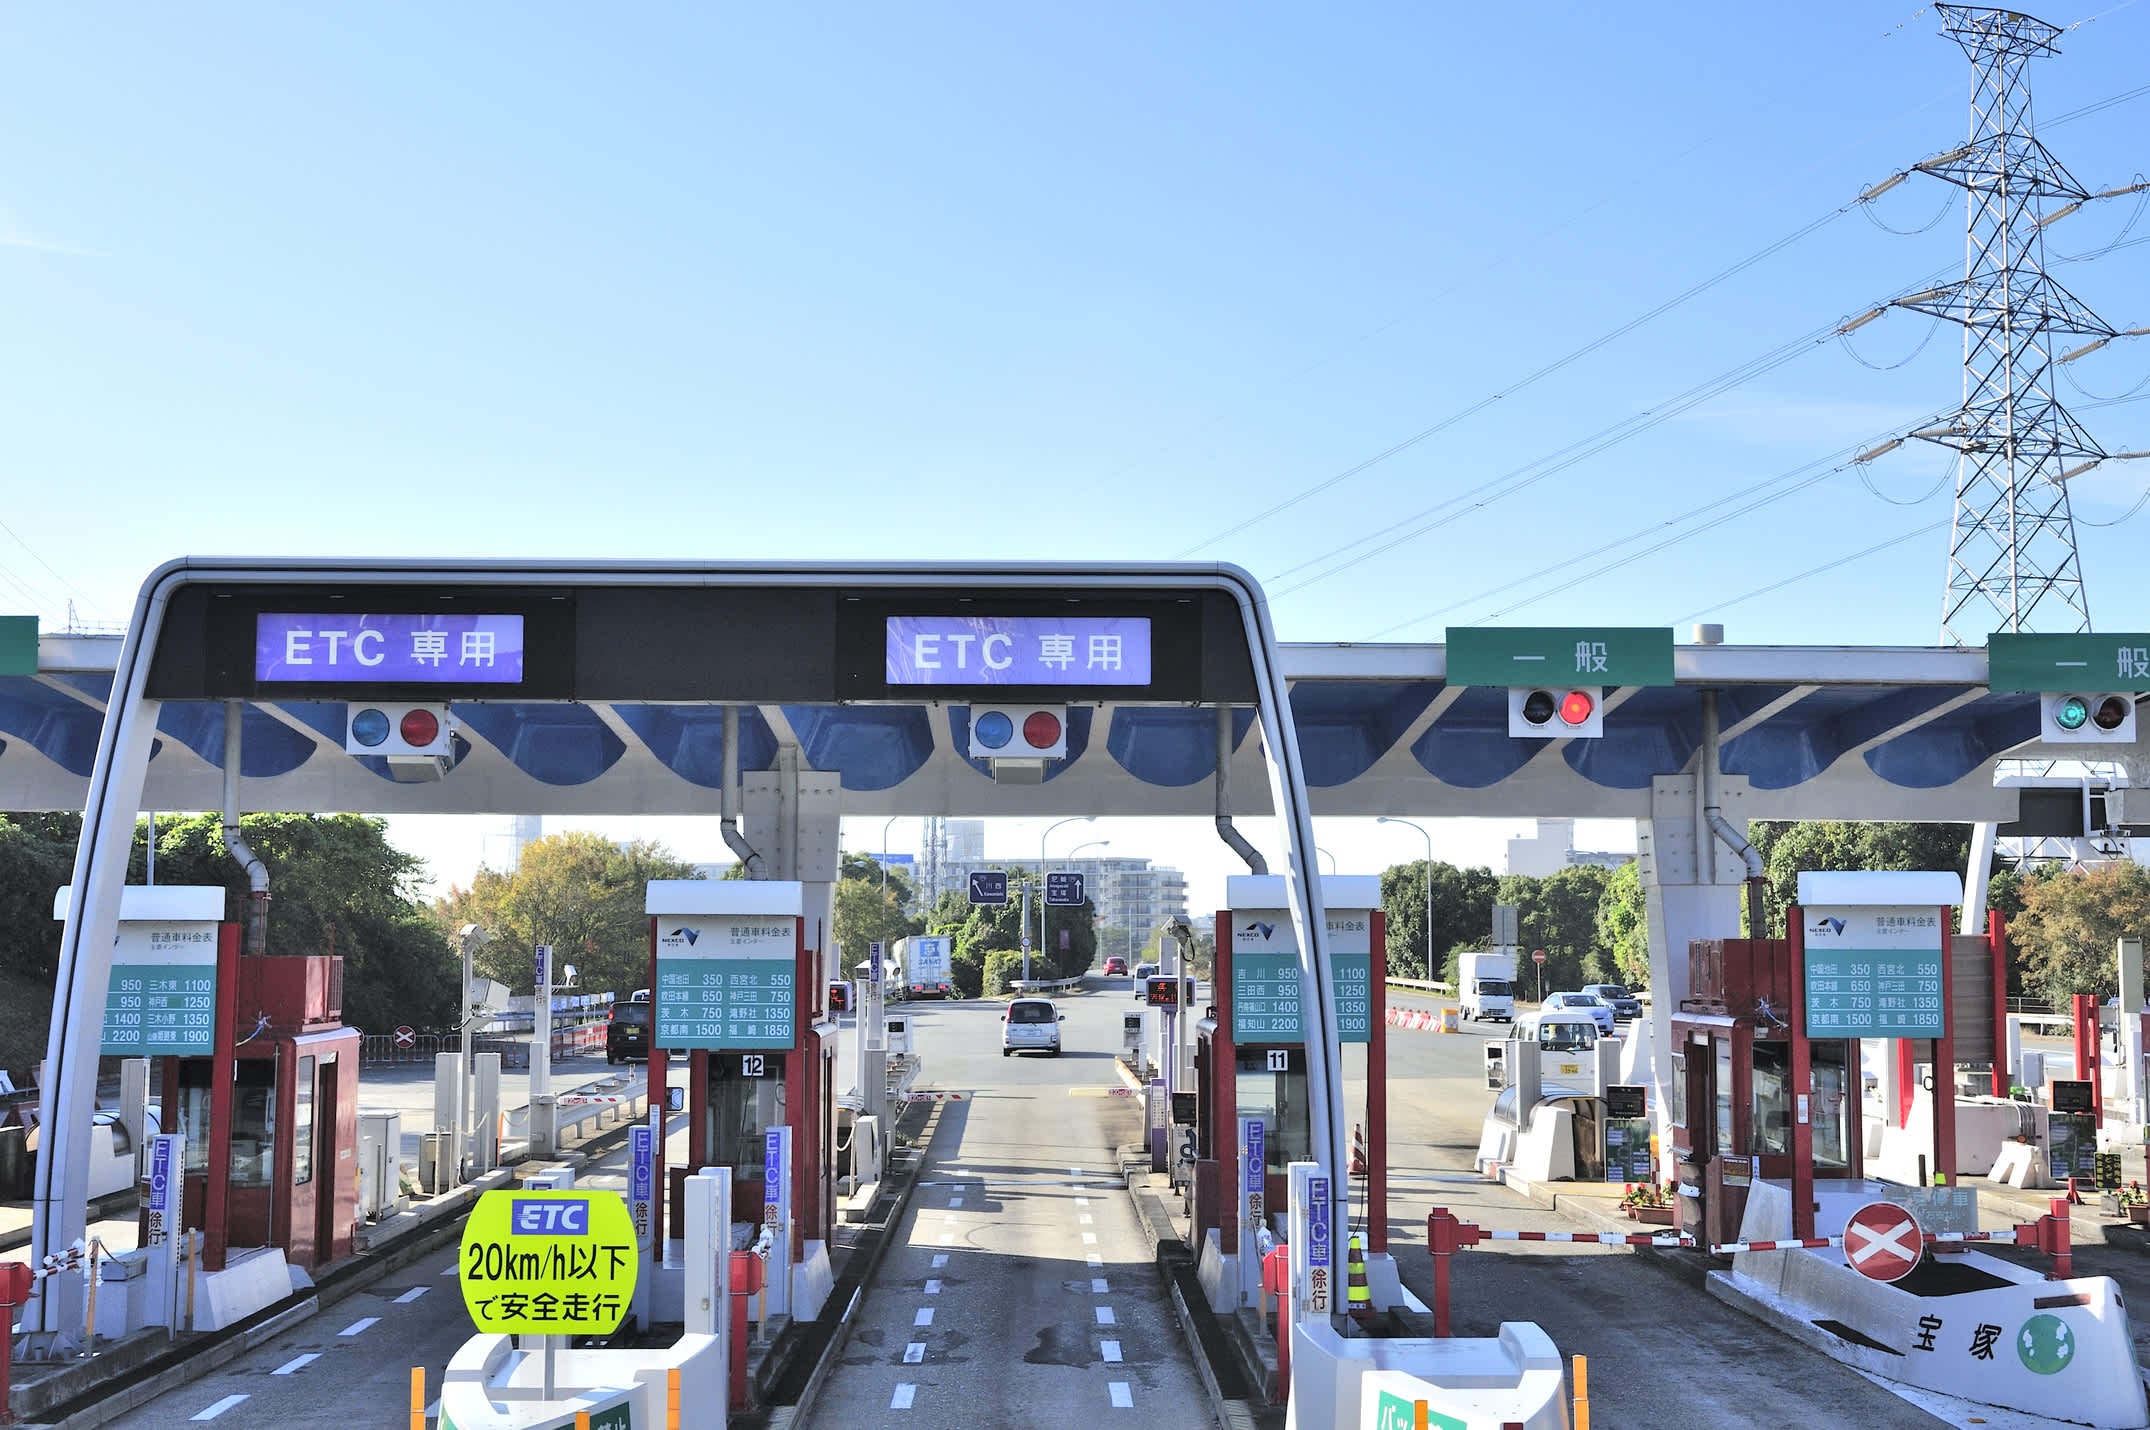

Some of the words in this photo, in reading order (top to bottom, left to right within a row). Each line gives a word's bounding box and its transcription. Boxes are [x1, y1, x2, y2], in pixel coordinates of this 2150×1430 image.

[286, 630, 385, 667] ETC
[410, 630, 495, 667] 専用
[915, 633, 1013, 670] ETC
[1038, 634, 1122, 671] 専用
[1876, 917, 1937, 927] 普通車料金表
[151, 932, 213, 943] 普通車料金表
[731, 927, 791, 937] 普通車料金表
[1278, 968, 1298, 979] 950
[1340, 968, 1365, 979] 1100
[1850, 964, 1870, 975] 350
[1878, 964, 1905, 975] 西宮北
[1917, 964, 1937, 975] 550
[662, 974, 689, 985] 中国池田
[702, 974, 722, 985] 350
[730, 975, 757, 985] 西宮北
[771, 975, 791, 986] 550
[121, 980, 142, 991] 950
[149, 980, 177, 991] 三木東
[185, 980, 211, 991] 1100
[1238, 985, 1265, 996] 三田西
[1278, 985, 1298, 996] 950
[1340, 985, 1365, 996] 1250
[1850, 980, 1871, 992] 650
[1918, 981, 1938, 992] 750
[702, 991, 722, 1002] 650
[730, 992, 757, 1002] 神戸三田
[771, 992, 791, 1002] 750
[120, 997, 141, 1008] 950
[184, 997, 210, 1008] 1250
[1272, 1001, 1298, 1013] 1400
[1340, 1001, 1365, 1012] 1350
[1851, 997, 1871, 1008] 750
[1913, 997, 1938, 1008] 1350
[115, 1013, 141, 1025] 1400
[148, 1014, 176, 1025] 三木小野
[184, 1013, 210, 1025] 1350
[702, 1008, 722, 1019] 750
[764, 1008, 790, 1019] 1350
[1811, 1014, 1839, 1025] 京都南
[1846, 1013, 1872, 1025] 1500
[1912, 1013, 1939, 1025] 1850
[1238, 1018, 1265, 1029] 福知山
[1271, 1018, 1298, 1030] 2200
[1340, 1018, 1365, 1030] 1900
[660, 1024, 689, 1036] 京都南
[696, 1024, 722, 1036] 1500
[764, 1025, 790, 1036] 1850
[113, 1030, 140, 1042] 2200
[183, 1030, 209, 1042] 1900
[744, 1057, 762, 1074] 12
[1270, 1053, 1286, 1069] 11
[516, 1204, 584, 1230] ETC
[468, 1243, 630, 1281] 20km/h以下
[475, 1292, 621, 1321] で安全走行
[1912, 1313, 2002, 1360] 宝塚
